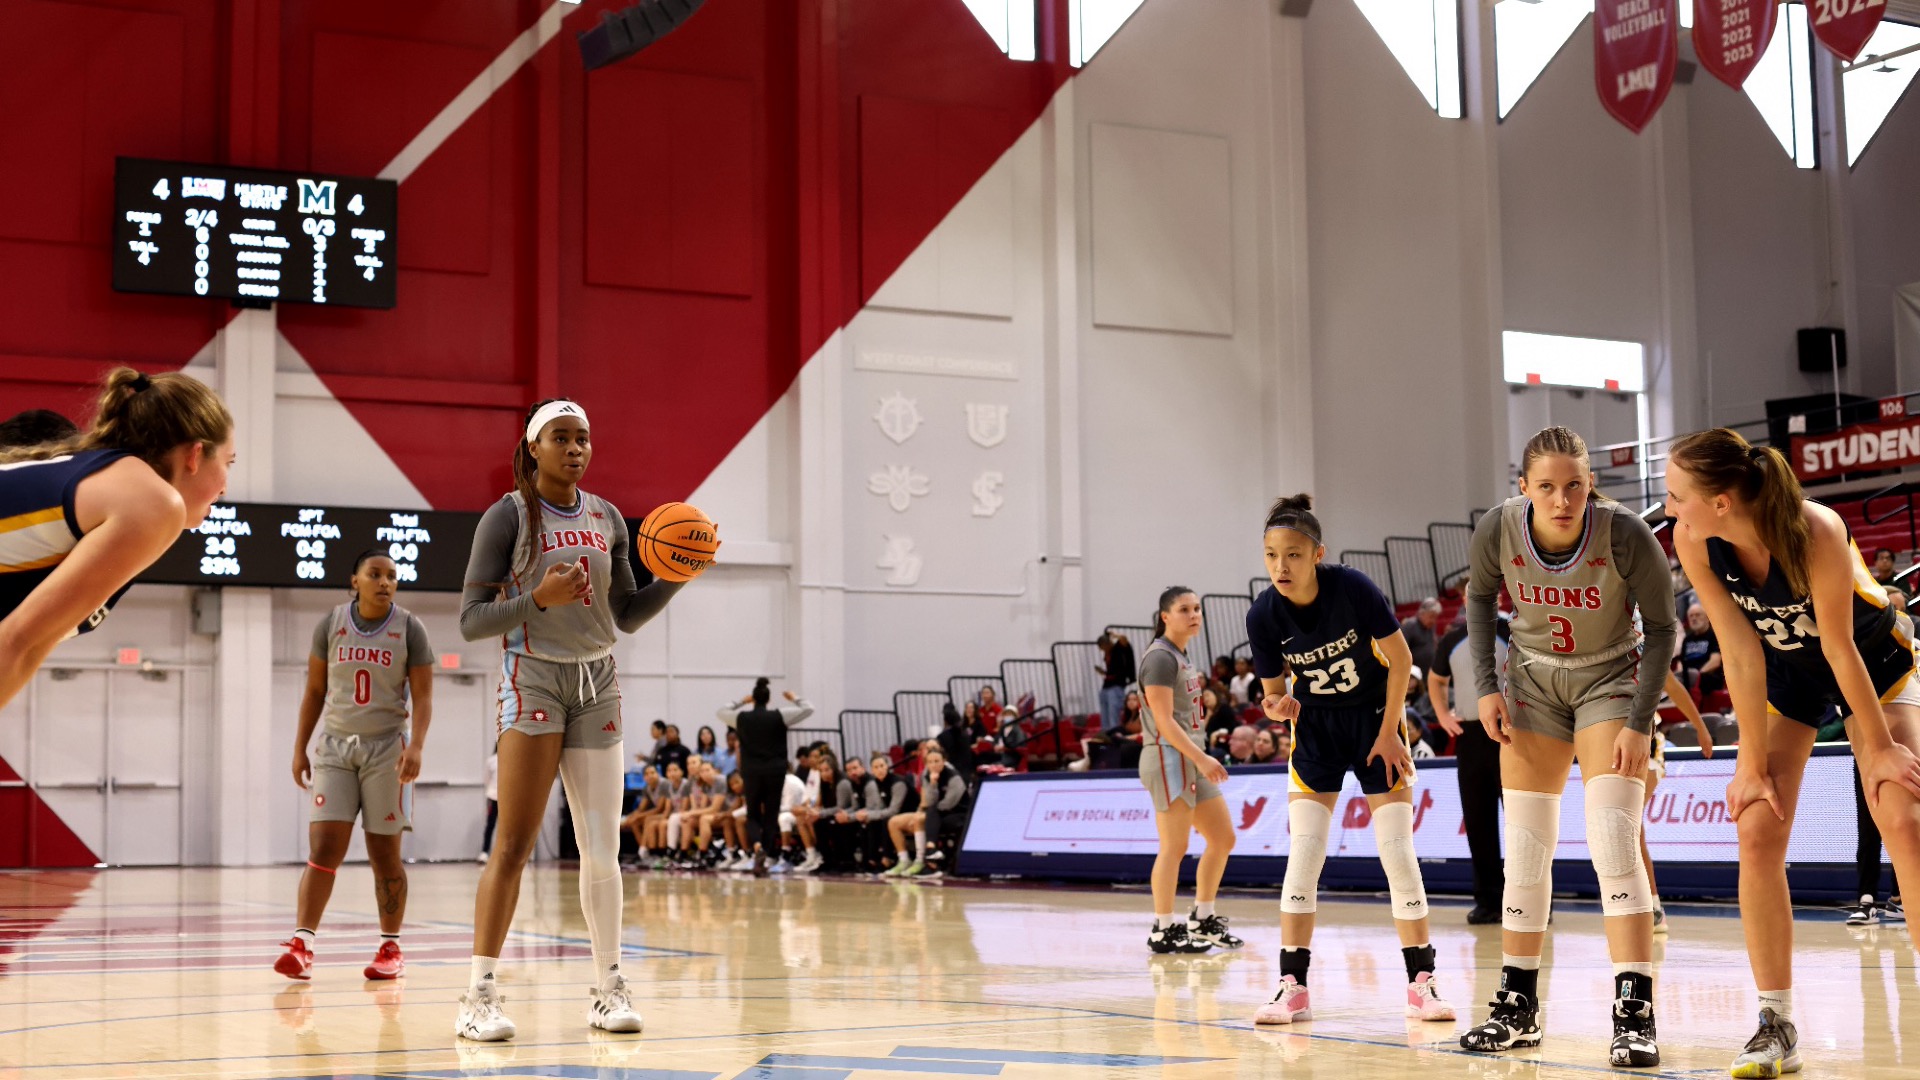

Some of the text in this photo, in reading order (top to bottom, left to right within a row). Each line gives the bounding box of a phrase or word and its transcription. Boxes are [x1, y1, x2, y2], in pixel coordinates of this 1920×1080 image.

[1604, 8, 1667, 44] VOLLEYBALL
[1722, 9, 1750, 29] 2021
[1722, 25, 1752, 48] 2022
[1723, 43, 1754, 66] 2023
[1617, 63, 1658, 100] LMU
[152, 178, 171, 200] 4
[297, 178, 338, 216] M
[347, 193, 365, 216] 4
[185, 208, 219, 228] 2/4
[1881, 401, 1904, 416] 106
[538, 530, 608, 555] LIONS
[1516, 580, 1602, 611] LIONS
[1547, 613, 1576, 653] 3
[337, 645, 393, 668] LIONS
[1281, 628, 1359, 666] MASTER'S
[354, 668, 372, 706] 0
[1302, 657, 1361, 695] 23
[1066, 809, 1079, 821] ON
[1081, 808, 1114, 821] SOCIAL
[1119, 808, 1149, 821] MEDIA
